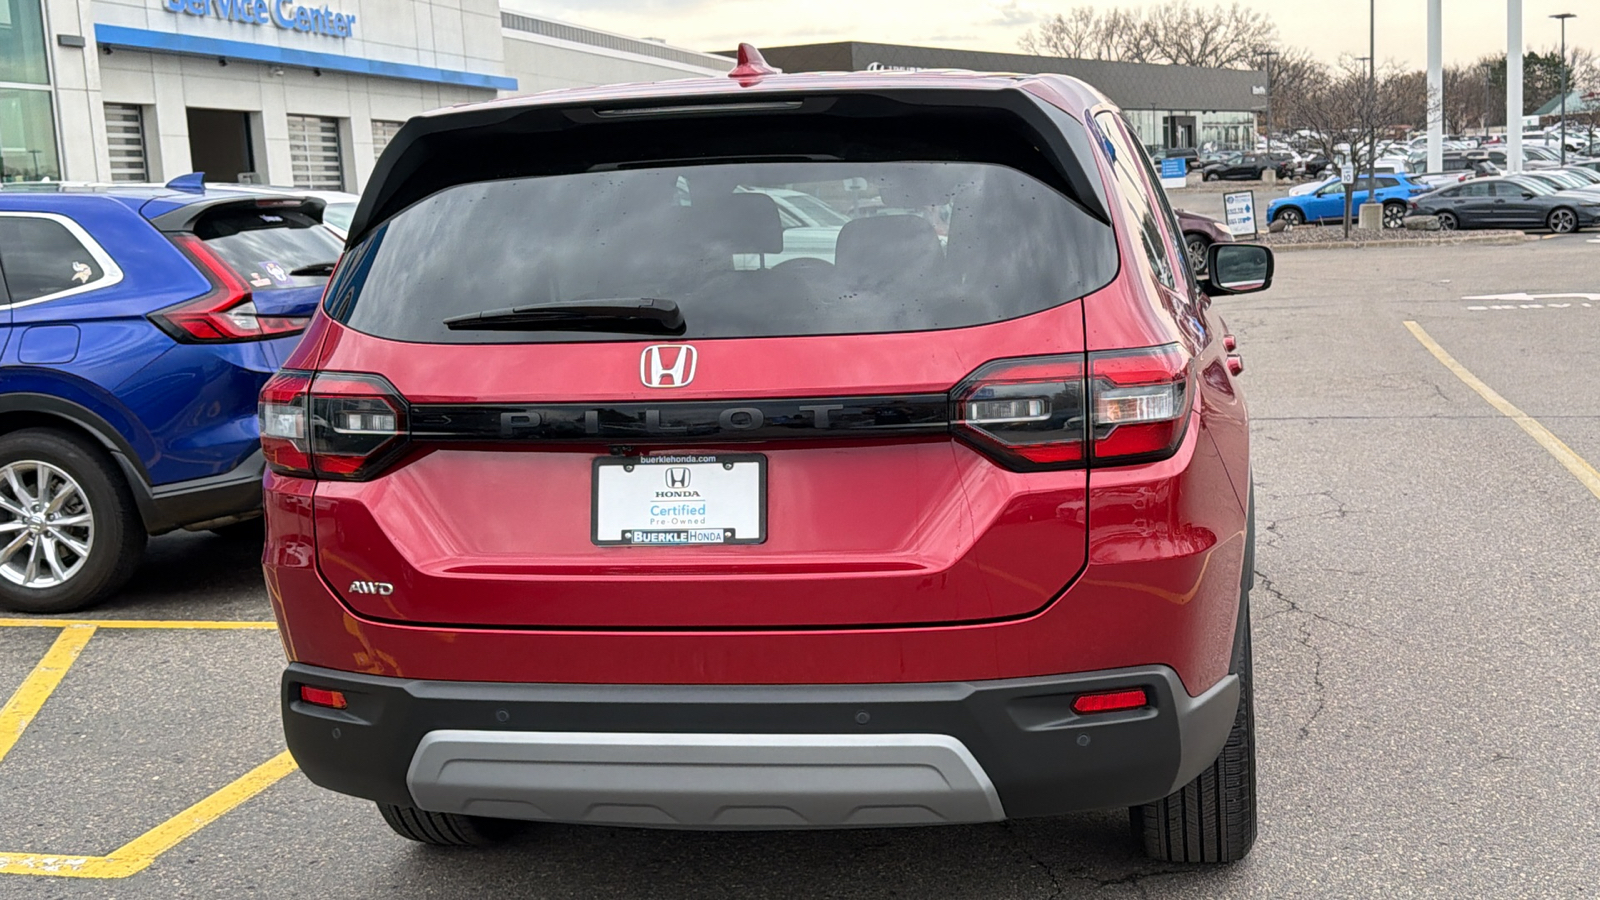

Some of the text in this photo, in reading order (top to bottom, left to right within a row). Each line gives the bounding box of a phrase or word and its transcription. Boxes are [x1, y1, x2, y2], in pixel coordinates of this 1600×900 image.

[270, 0, 356, 37] Center
[500, 404, 844, 434] PILOT
[640, 455, 717, 464] buerklehonda.com
[650, 504, 706, 516] Certified
[650, 517, 706, 525] Pre-Owned
[348, 581, 394, 596] AWD
